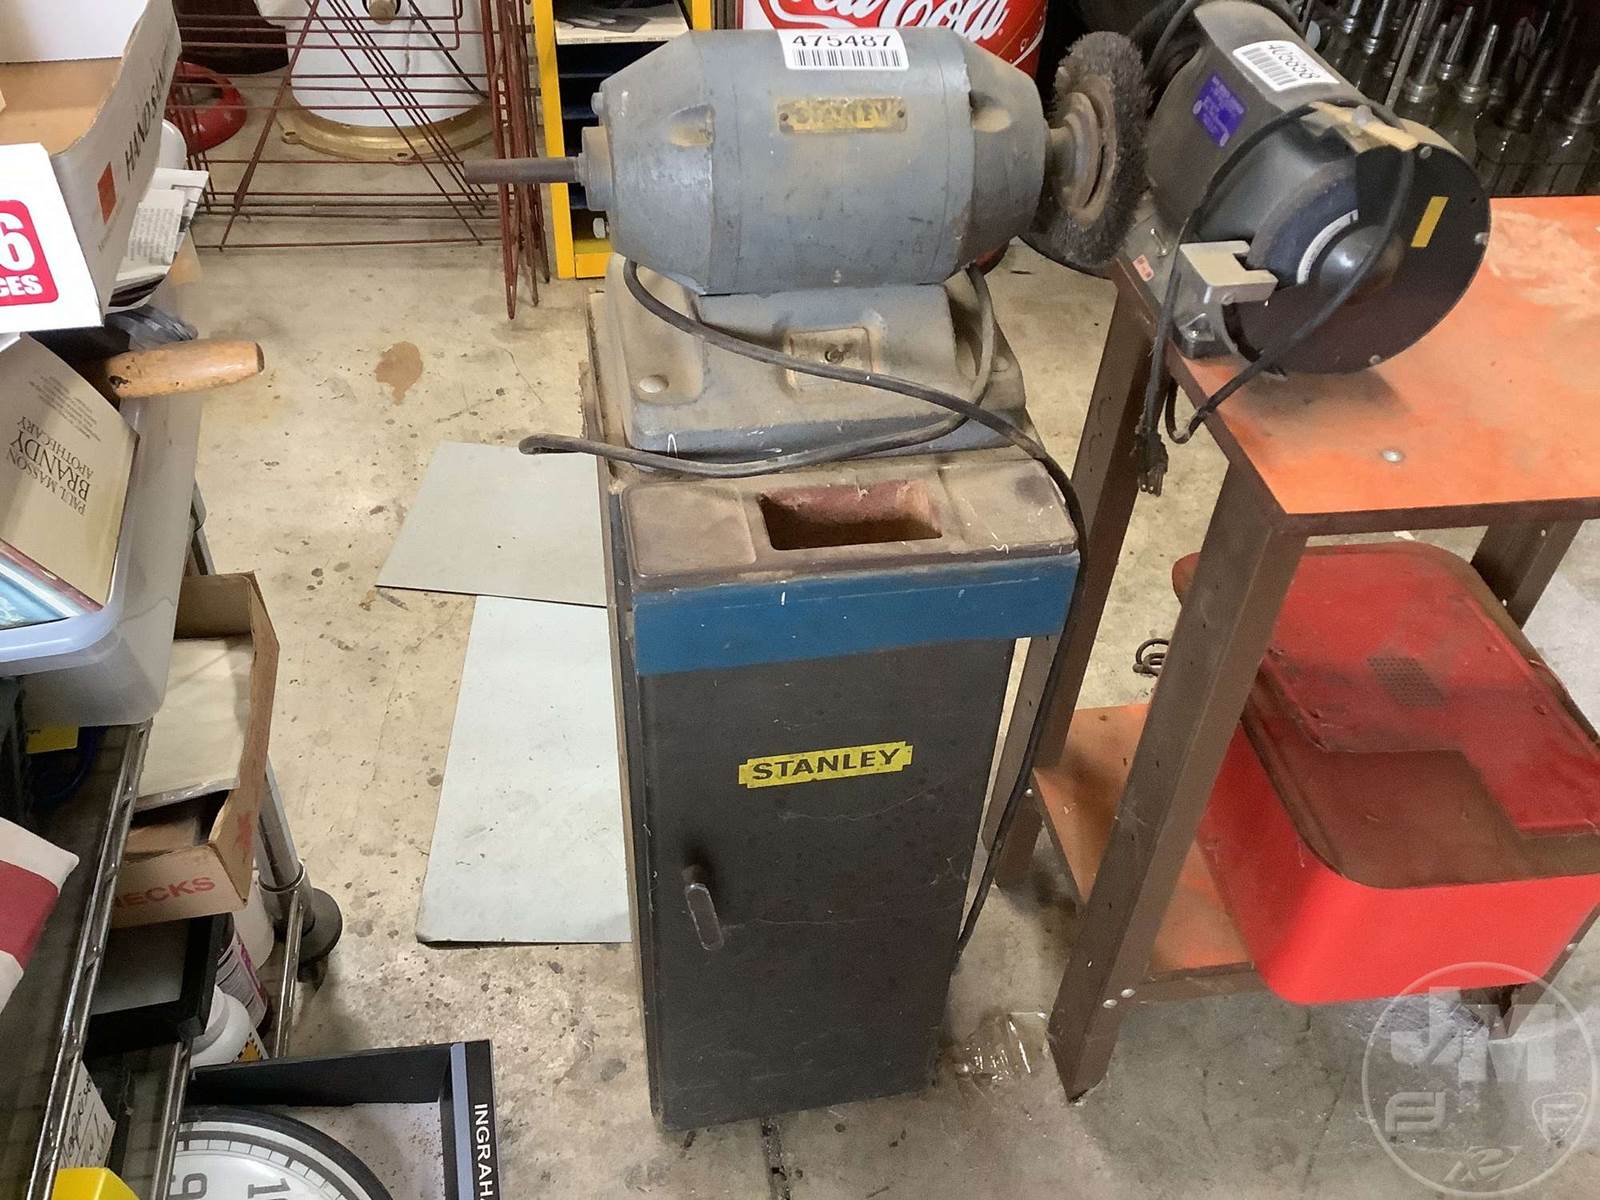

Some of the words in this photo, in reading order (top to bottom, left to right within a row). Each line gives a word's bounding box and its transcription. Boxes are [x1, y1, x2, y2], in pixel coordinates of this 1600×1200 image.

[792, 35, 891, 47] 475487
[7, 446, 58, 493] MASSON
[10, 430, 90, 502] BRANDY
[17, 416, 94, 479] APOTHECARY
[60, 486, 87, 516] PAUL
[752, 748, 900, 780] STANLEY
[474, 1104, 494, 1200] INGRAH
